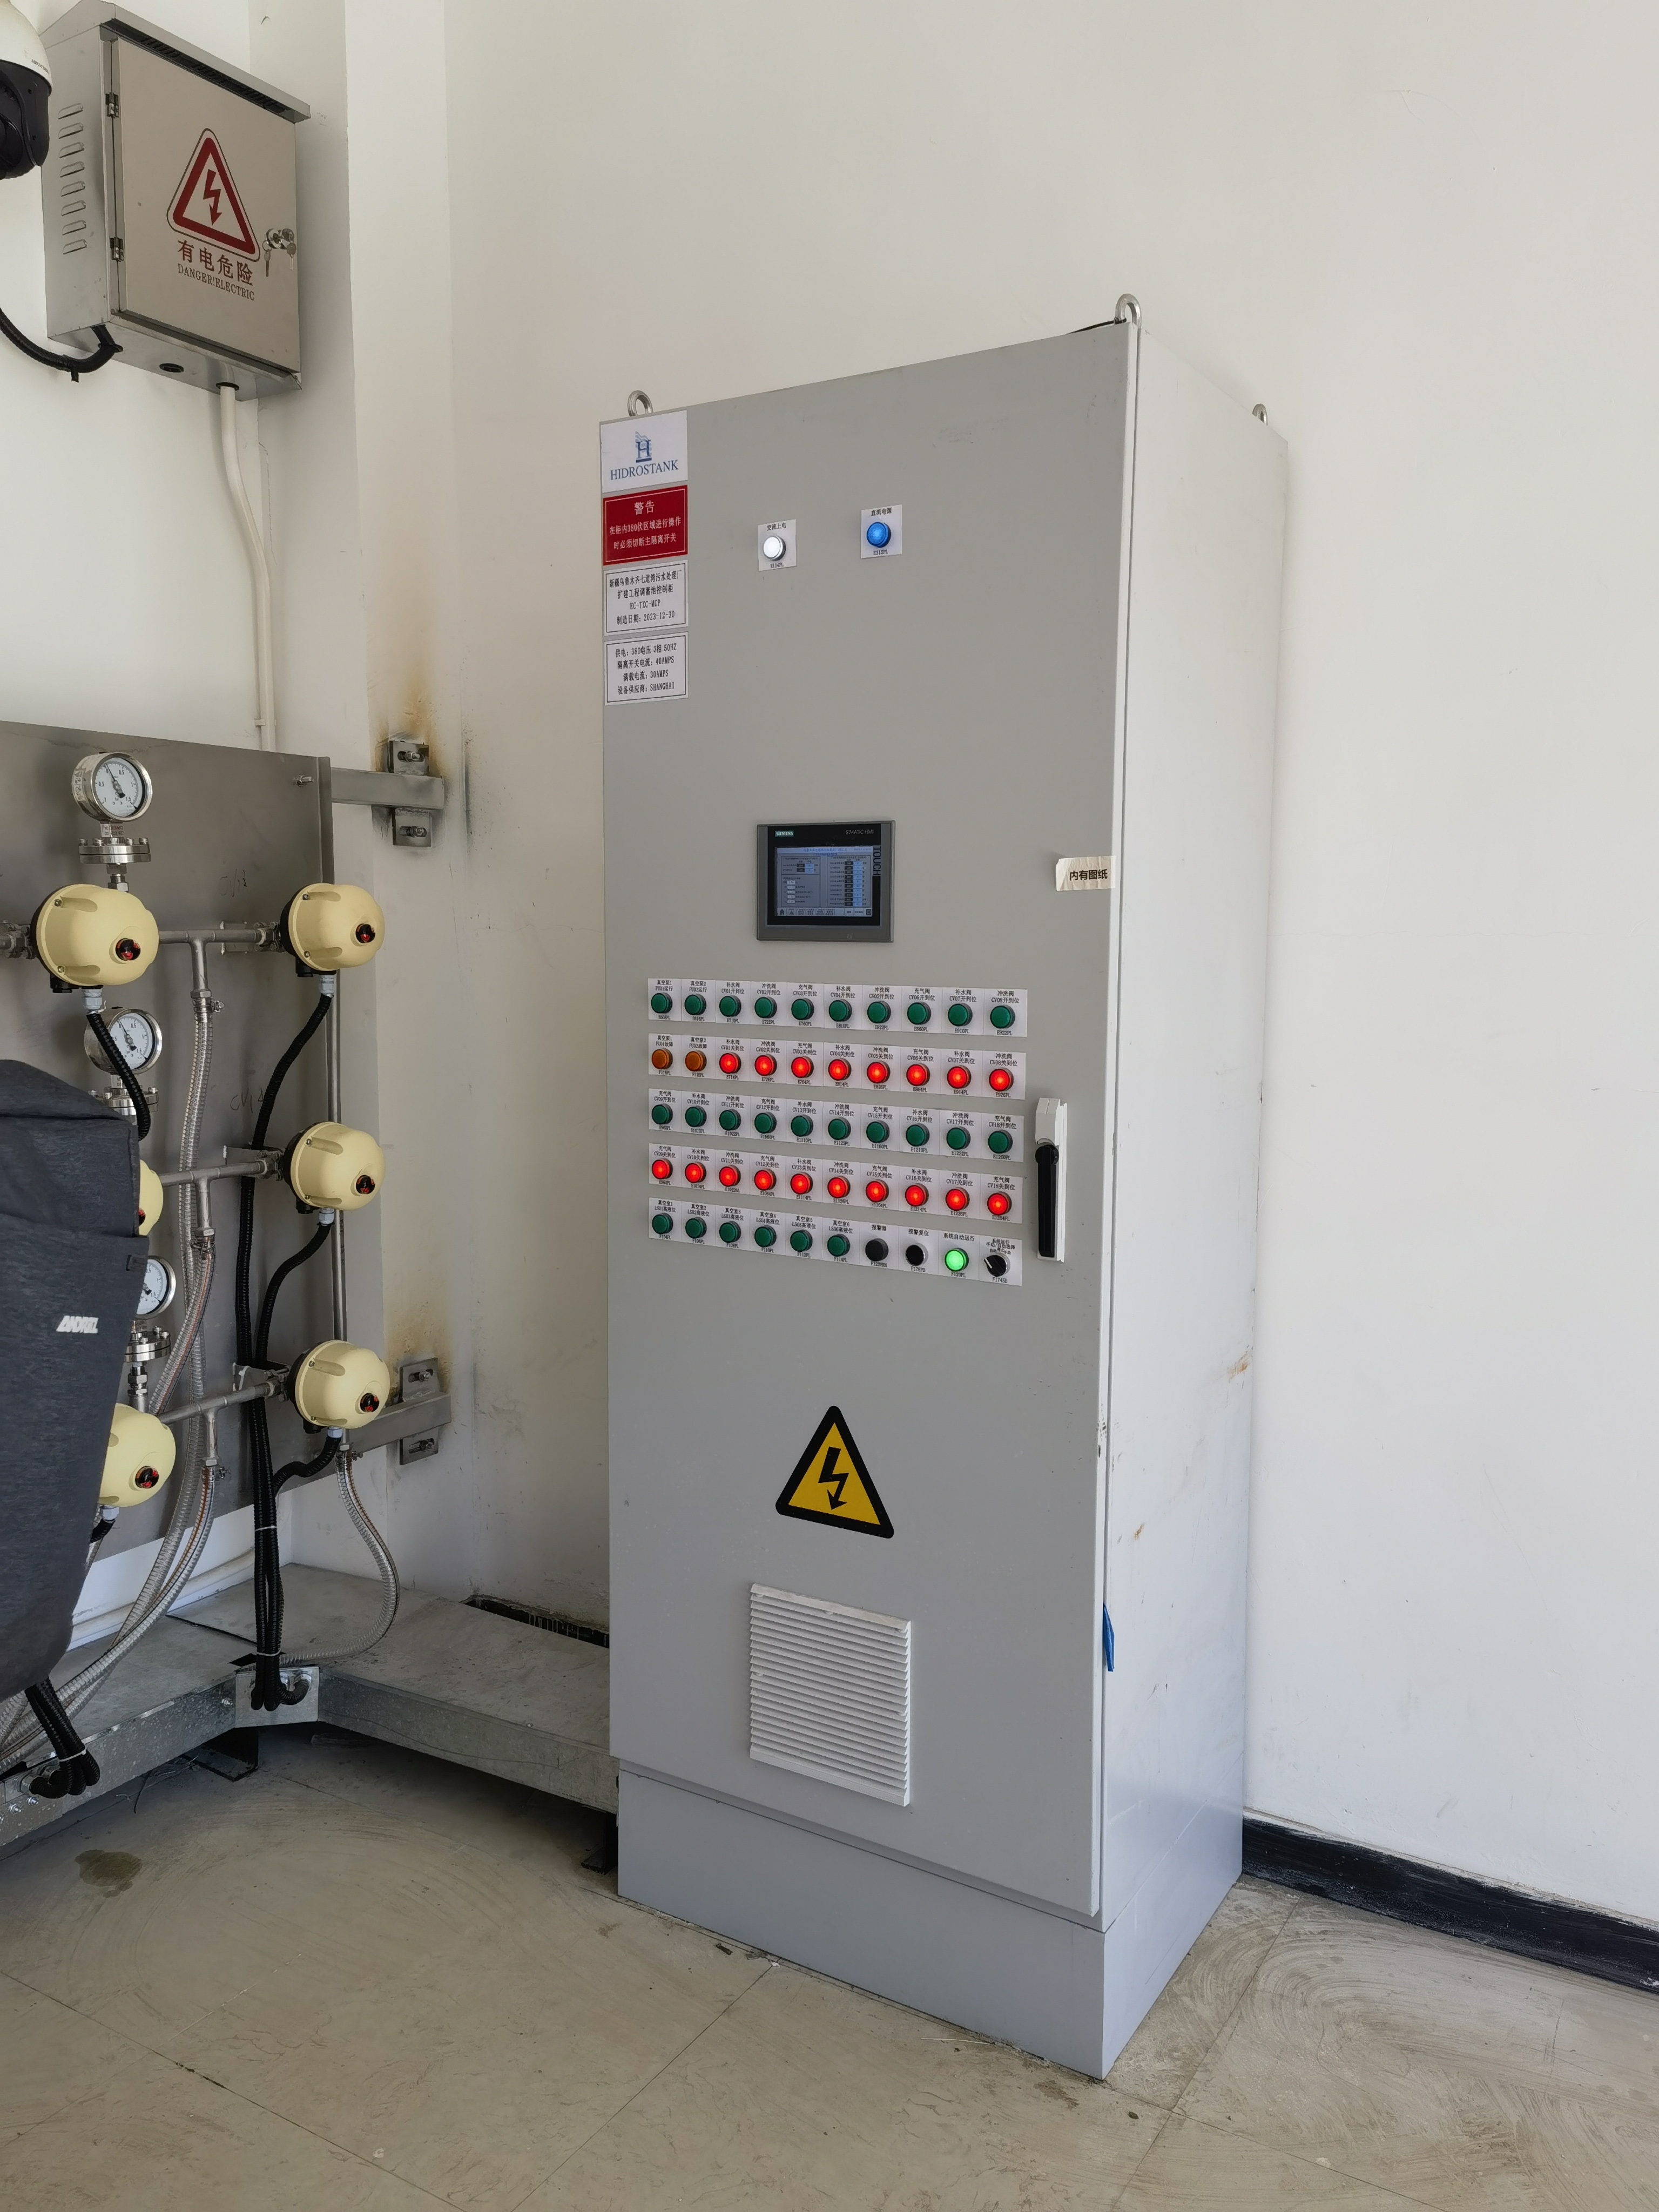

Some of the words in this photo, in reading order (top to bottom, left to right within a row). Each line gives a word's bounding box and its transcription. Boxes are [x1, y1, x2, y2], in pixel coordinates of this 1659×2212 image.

[177, 239, 253, 286] 有电危险
[178, 264, 254, 301] DANGER!ELECTRIC
[611, 460, 678, 480] HIDROSTANK
[634, 500, 655, 515] 警告
[871, 508, 892, 516] 直流电源
[610, 516, 681, 535] 在柜内380伏区域进行操作
[767, 522, 786, 531] 交流上电
[614, 532, 676, 550] 时必须切断主隔离开关
[609, 570, 682, 588] 新疆乌鲁木齐七道湾污水处理厂
[618, 584, 673, 599] 扩建工程调蓄池控制柜
[630, 599, 660, 610] EC-TXC-MCP
[653, 644, 662, 653] 3相
[664, 643, 677, 651] 50HZ
[873, 846, 882, 876] TOUCH
[1070, 869, 1108, 881] 内有图纸
[943, 1233, 975, 1242] 系统自动运行
